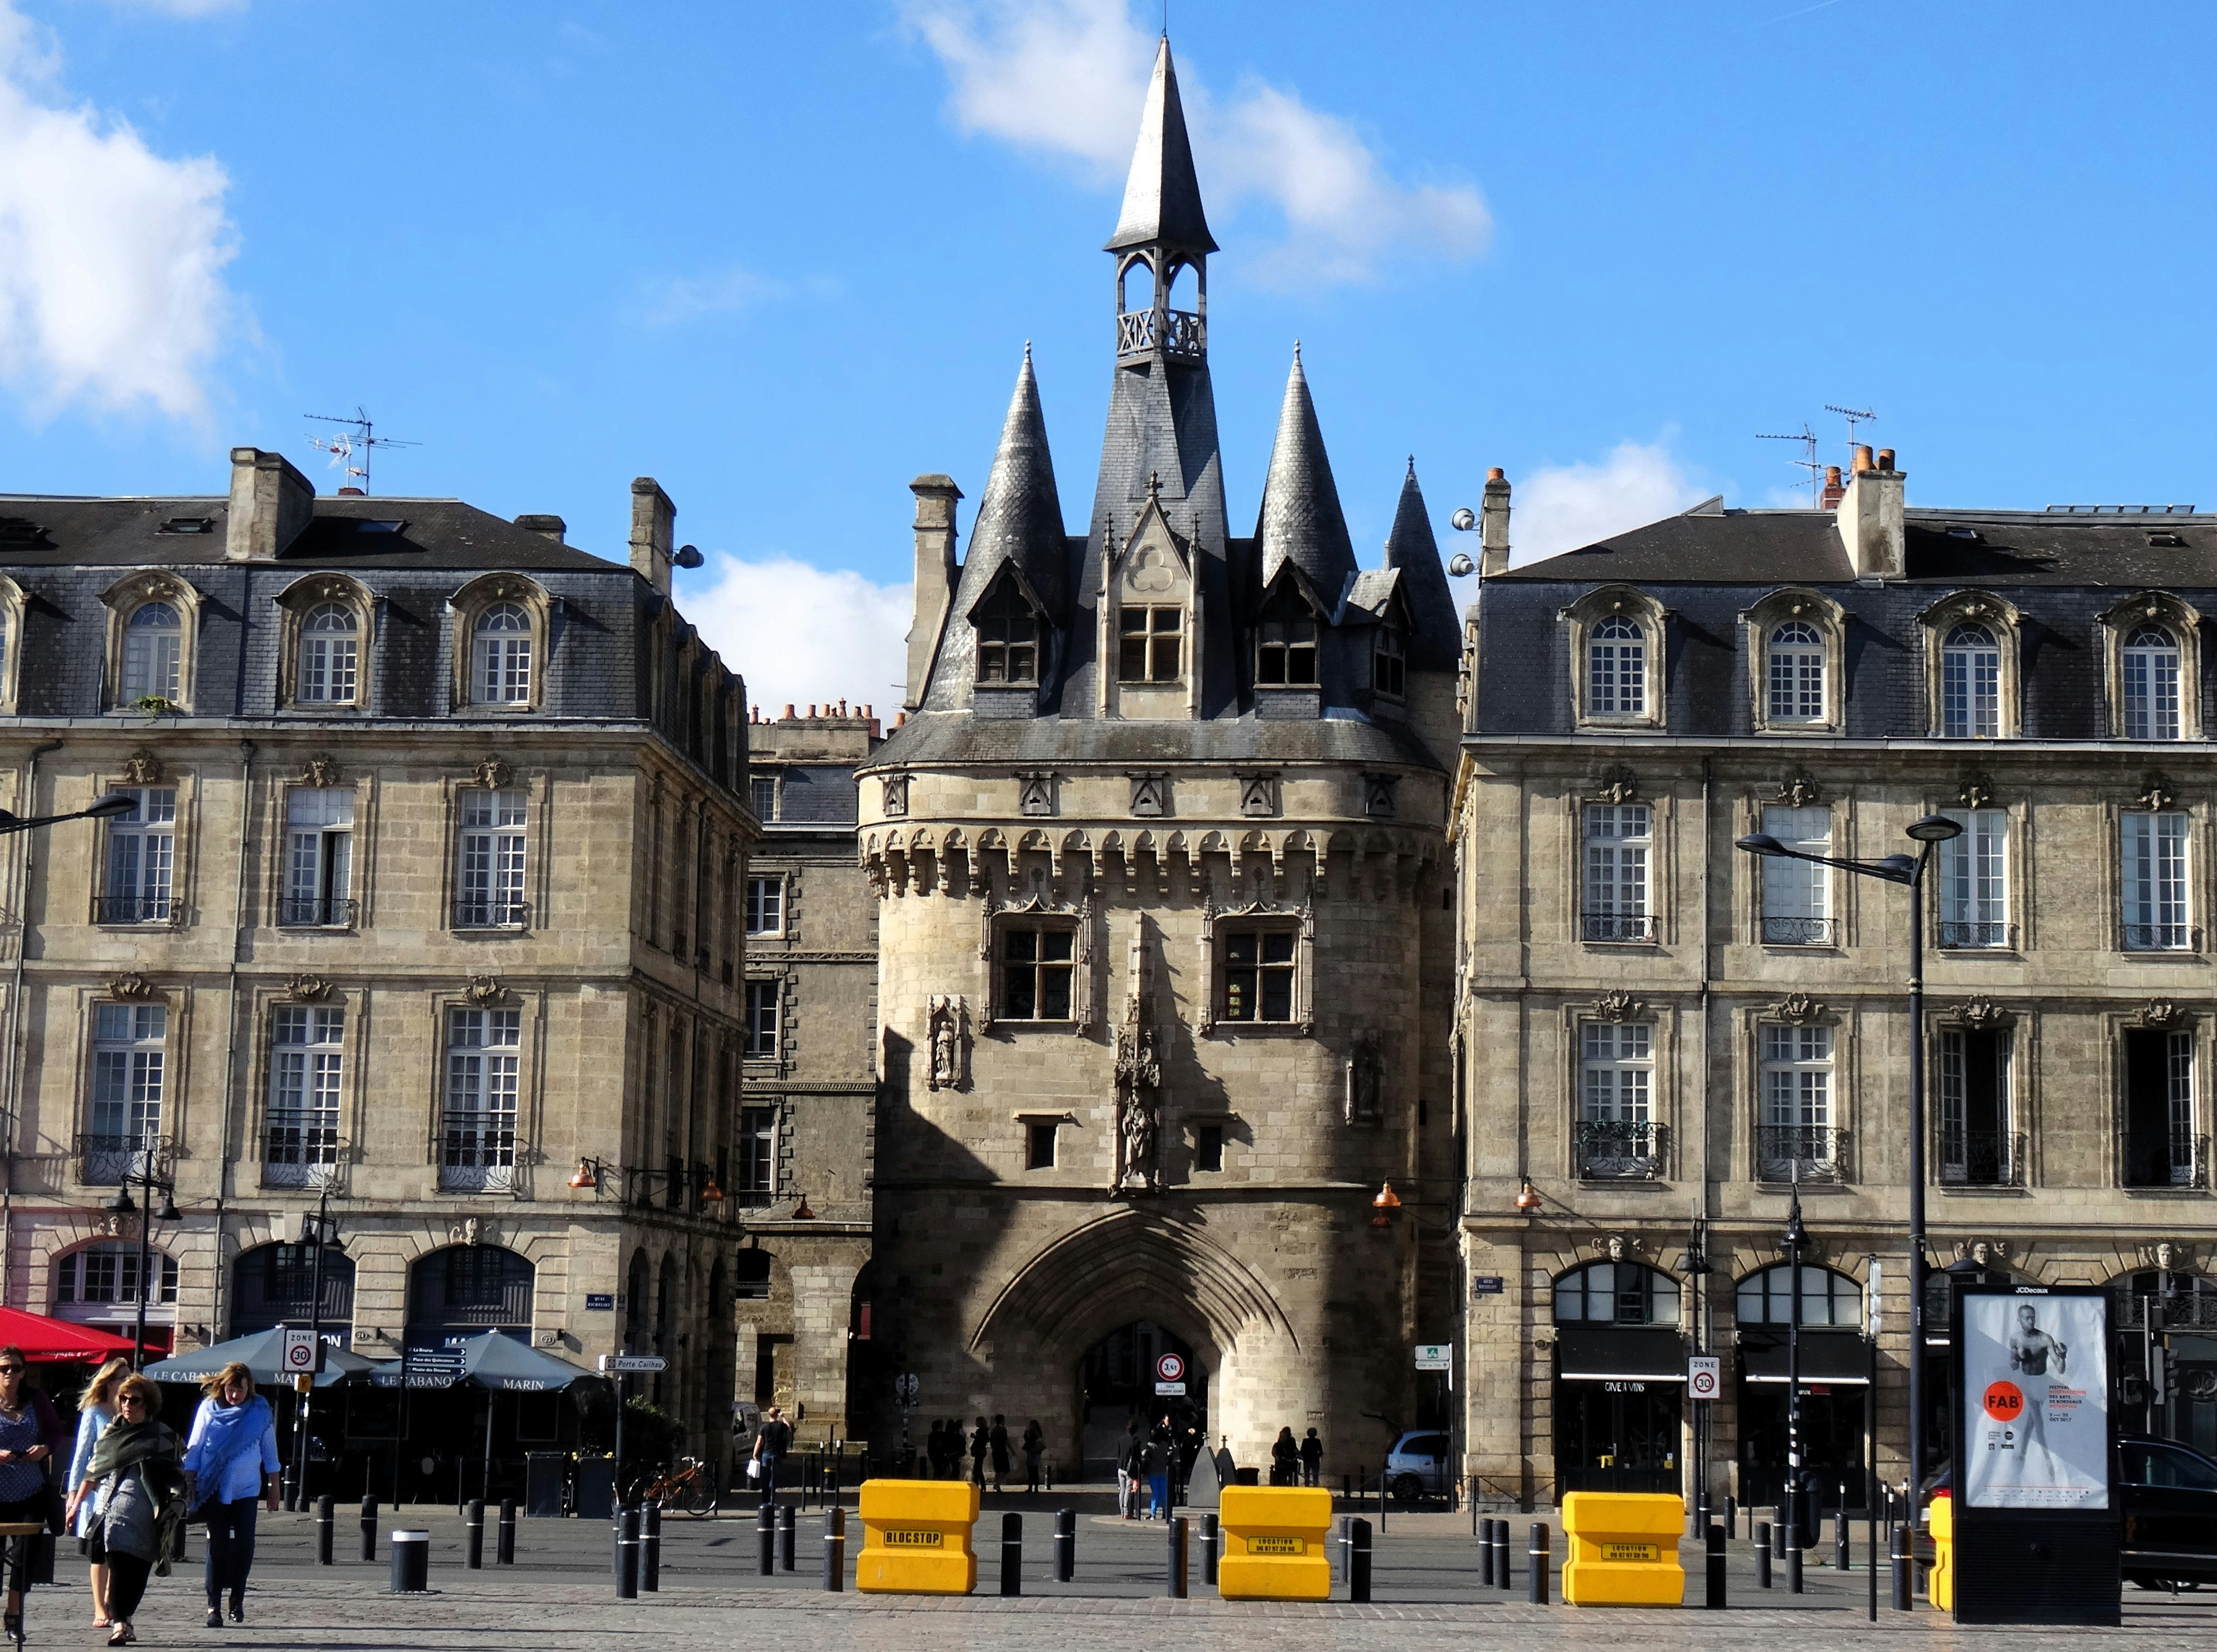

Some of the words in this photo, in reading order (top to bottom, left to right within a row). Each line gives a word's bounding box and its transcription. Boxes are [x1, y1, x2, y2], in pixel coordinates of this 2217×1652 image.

[294, 1351, 307, 1360] 30
[153, 1371, 168, 1380] LE
[382, 1376, 396, 1386] LE
[503, 1379, 544, 1390] MARIN
[1698, 1379, 1711, 1388] 30
[1989, 1395, 2019, 1408] FAB
